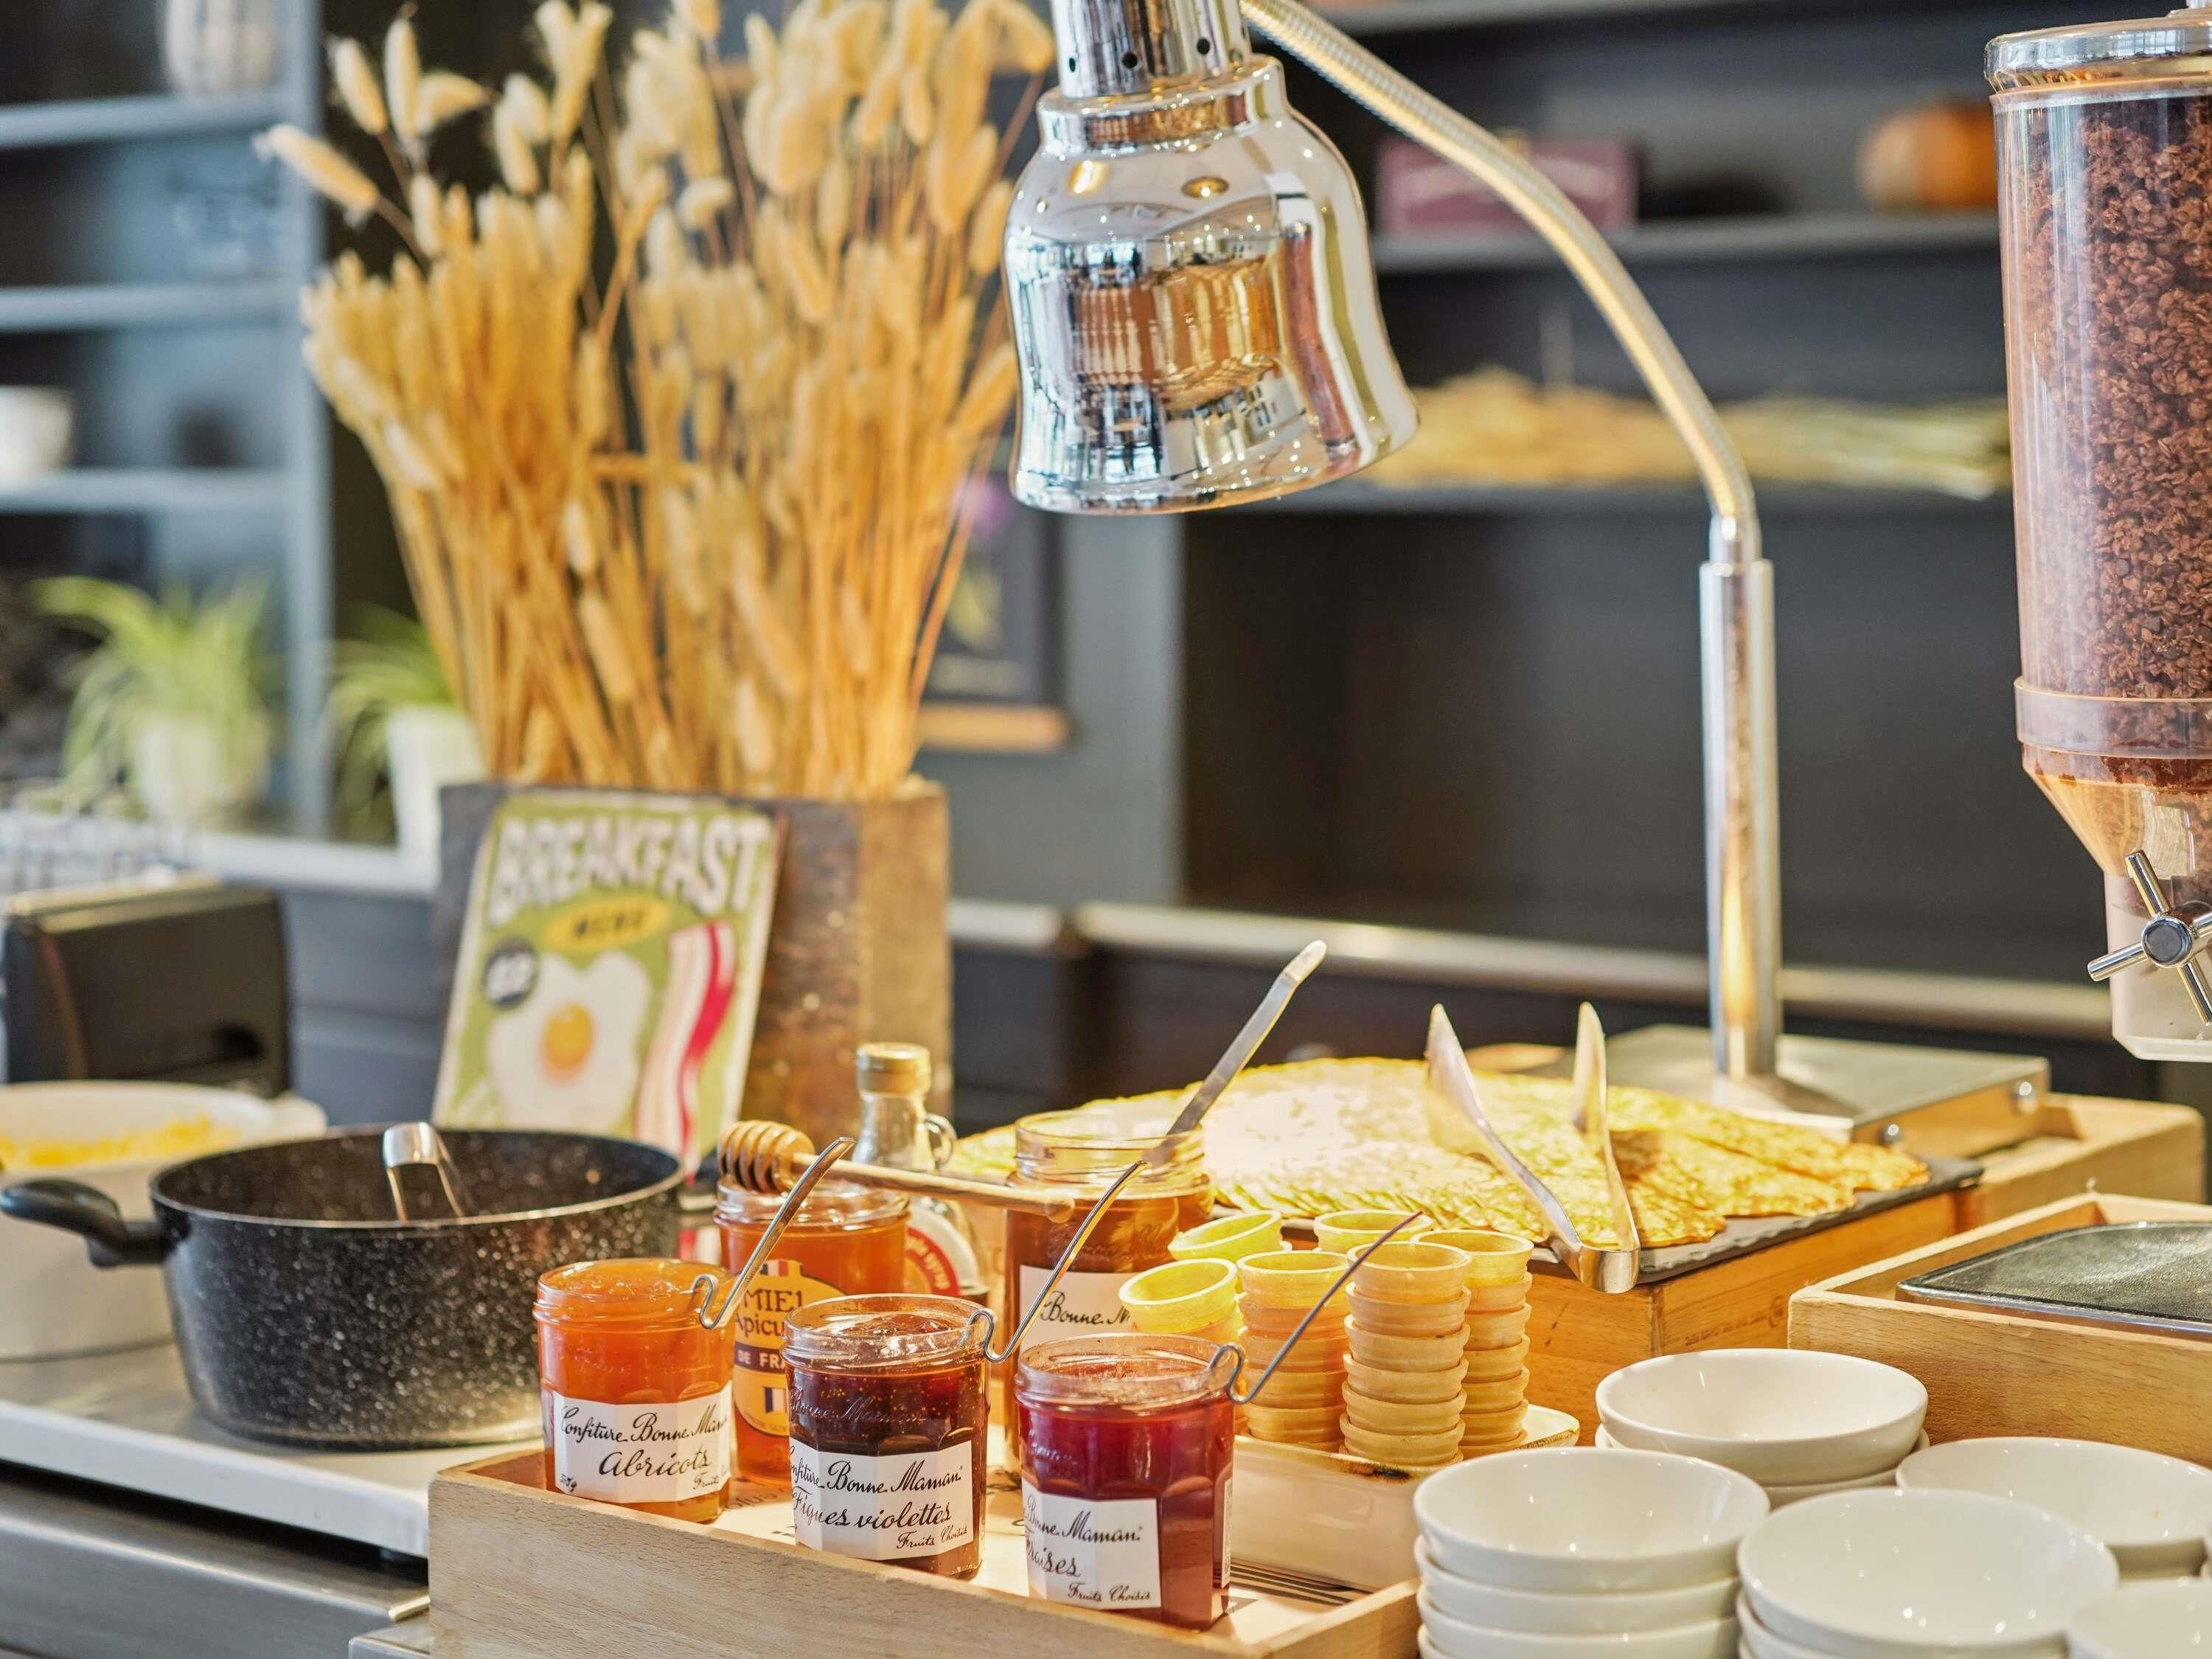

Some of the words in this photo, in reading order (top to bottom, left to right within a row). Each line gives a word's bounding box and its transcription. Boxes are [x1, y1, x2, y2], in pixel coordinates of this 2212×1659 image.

[488, 814, 771, 926] BREAKFAST
[630, 1412, 689, 1442] Bonne
[599, 1446, 712, 1478] Abricots
[790, 1445, 825, 1489] nfiture
[827, 1460, 888, 1494] Bonne
[791, 1486, 851, 1526] Figues
[854, 1501, 953, 1529] violettes
[896, 1531, 935, 1549] Fruits
[940, 1525, 967, 1544] Choisis
[1068, 1582, 1103, 1602] Fruits
[1109, 1585, 1151, 1602] Choisis
